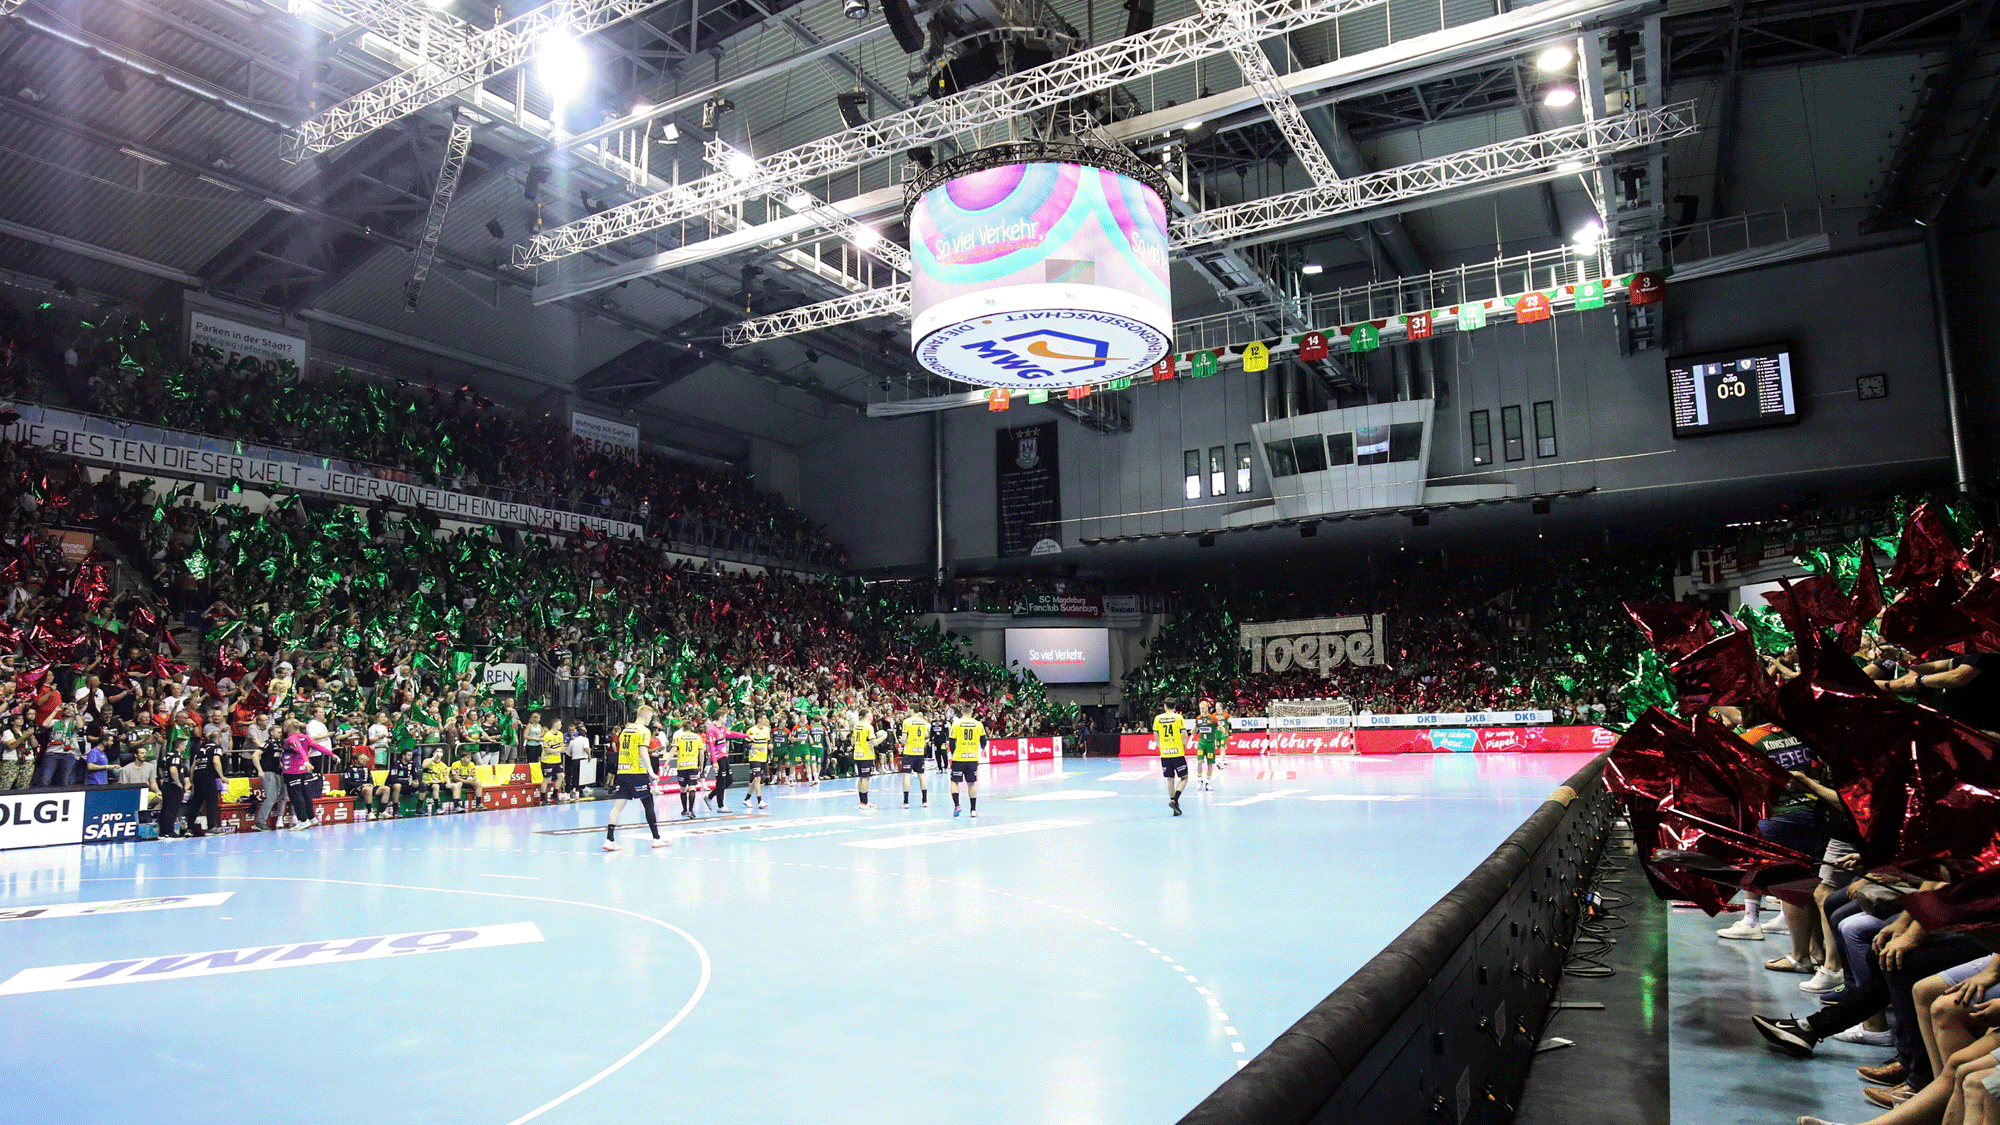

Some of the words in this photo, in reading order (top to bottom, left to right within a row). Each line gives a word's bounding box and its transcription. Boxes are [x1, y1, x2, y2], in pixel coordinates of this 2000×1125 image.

[935, 238, 950, 260] So
[953, 226, 975, 253] viel
[979, 217, 1044, 246] Verkehr.
[1643, 277, 1651, 287] 3
[1525, 296, 1538, 307] 73
[1412, 316, 1427, 329] 31
[944, 324, 976, 337] DIE
[196, 321, 230, 338] Parken
[232, 330, 242, 340] in
[244, 335, 260, 344] der
[261, 338, 293, 353] Stadt?
[1307, 335, 1319, 345] 14
[1250, 346, 1259, 356] 12
[960, 339, 1055, 380] MWG
[1160, 360, 1167, 370] 9
[1717, 381, 1746, 399] 0:0
[3, 421, 45, 447] DIE
[53, 430, 156, 465] BESTEN
[163, 447, 243, 479] DIESER
[250, 460, 302, 486] WELT
[320, 473, 381, 498] JEDER
[386, 483, 421, 505] VON
[425, 490, 467, 513] EUCH
[471, 497, 496, 518] EIN
[1039, 595, 1051, 603] SC
[1052, 596, 1086, 606] Magdeburg
[1029, 603, 1059, 612] Fanclub
[1239, 612, 1389, 679] Toepel
[1029, 649, 1040, 660] So
[1040, 648, 1054, 660] viel
[1054, 648, 1086, 661] Verkehr.
[1283, 718, 1302, 726] DKB
[1326, 717, 1345, 725] DKB
[1371, 716, 1391, 724] DKB
[1417, 715, 1437, 723] DKB
[1465, 714, 1486, 722] DKB
[1514, 713, 1536, 721] DKB
[1241, 719, 1259, 727] DKB
[963, 728, 973, 740] 80
[1163, 724, 1174, 738] 24
[814, 734, 821, 743] 10
[685, 740, 693, 752] 13
[101, 812, 122, 824] pro
[84, 822, 137, 840] SAFE
